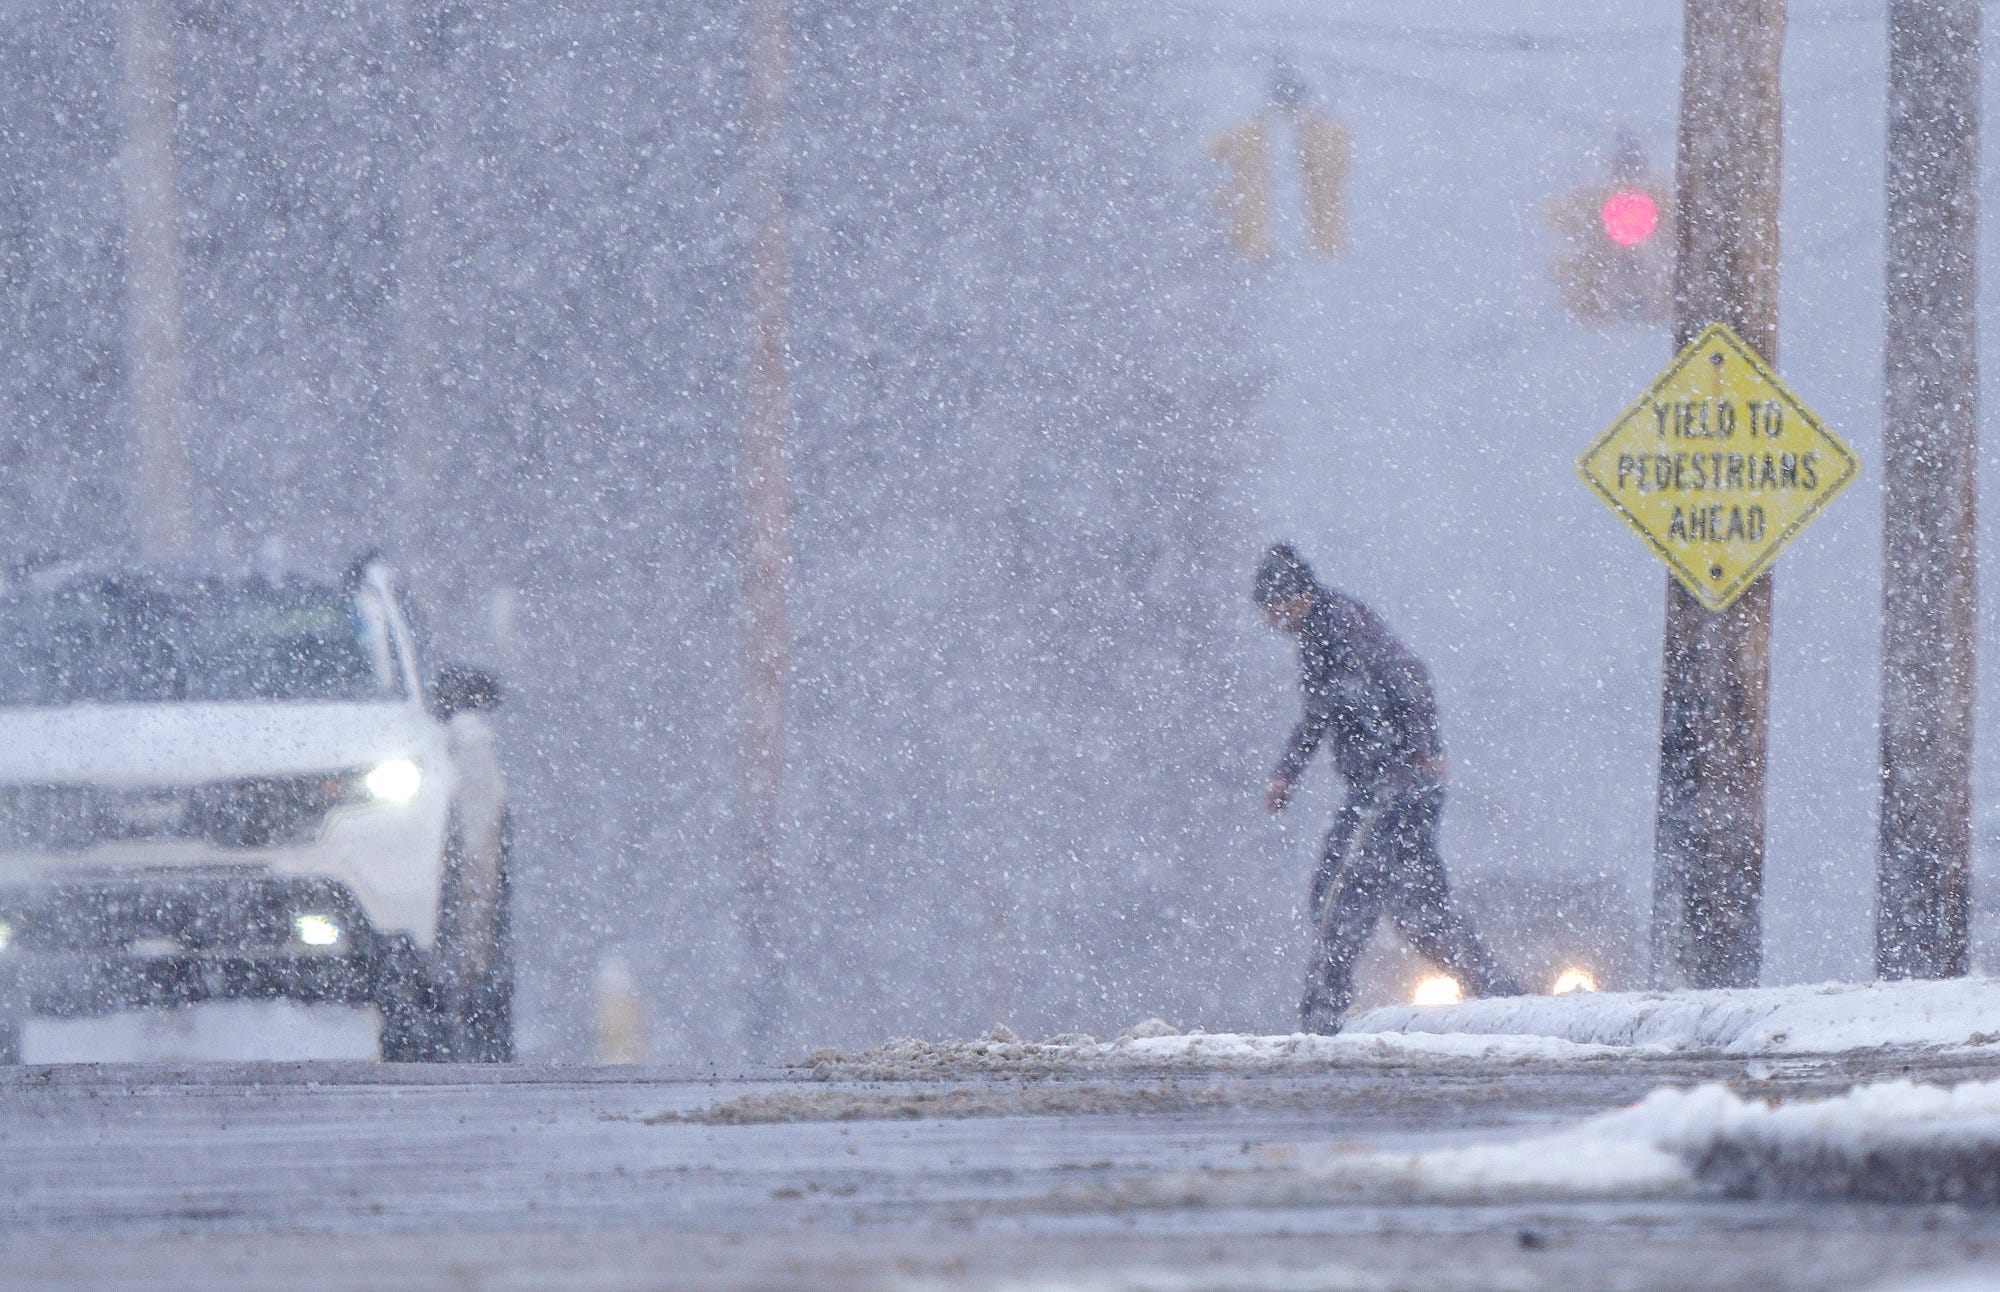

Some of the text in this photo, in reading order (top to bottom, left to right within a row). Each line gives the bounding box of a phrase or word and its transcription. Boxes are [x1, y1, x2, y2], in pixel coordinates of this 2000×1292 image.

[1652, 401, 1783, 439] YIELD TO
[1617, 452, 1818, 489] PEDESTRIANS
[1667, 505, 1765, 542] AHEAD
